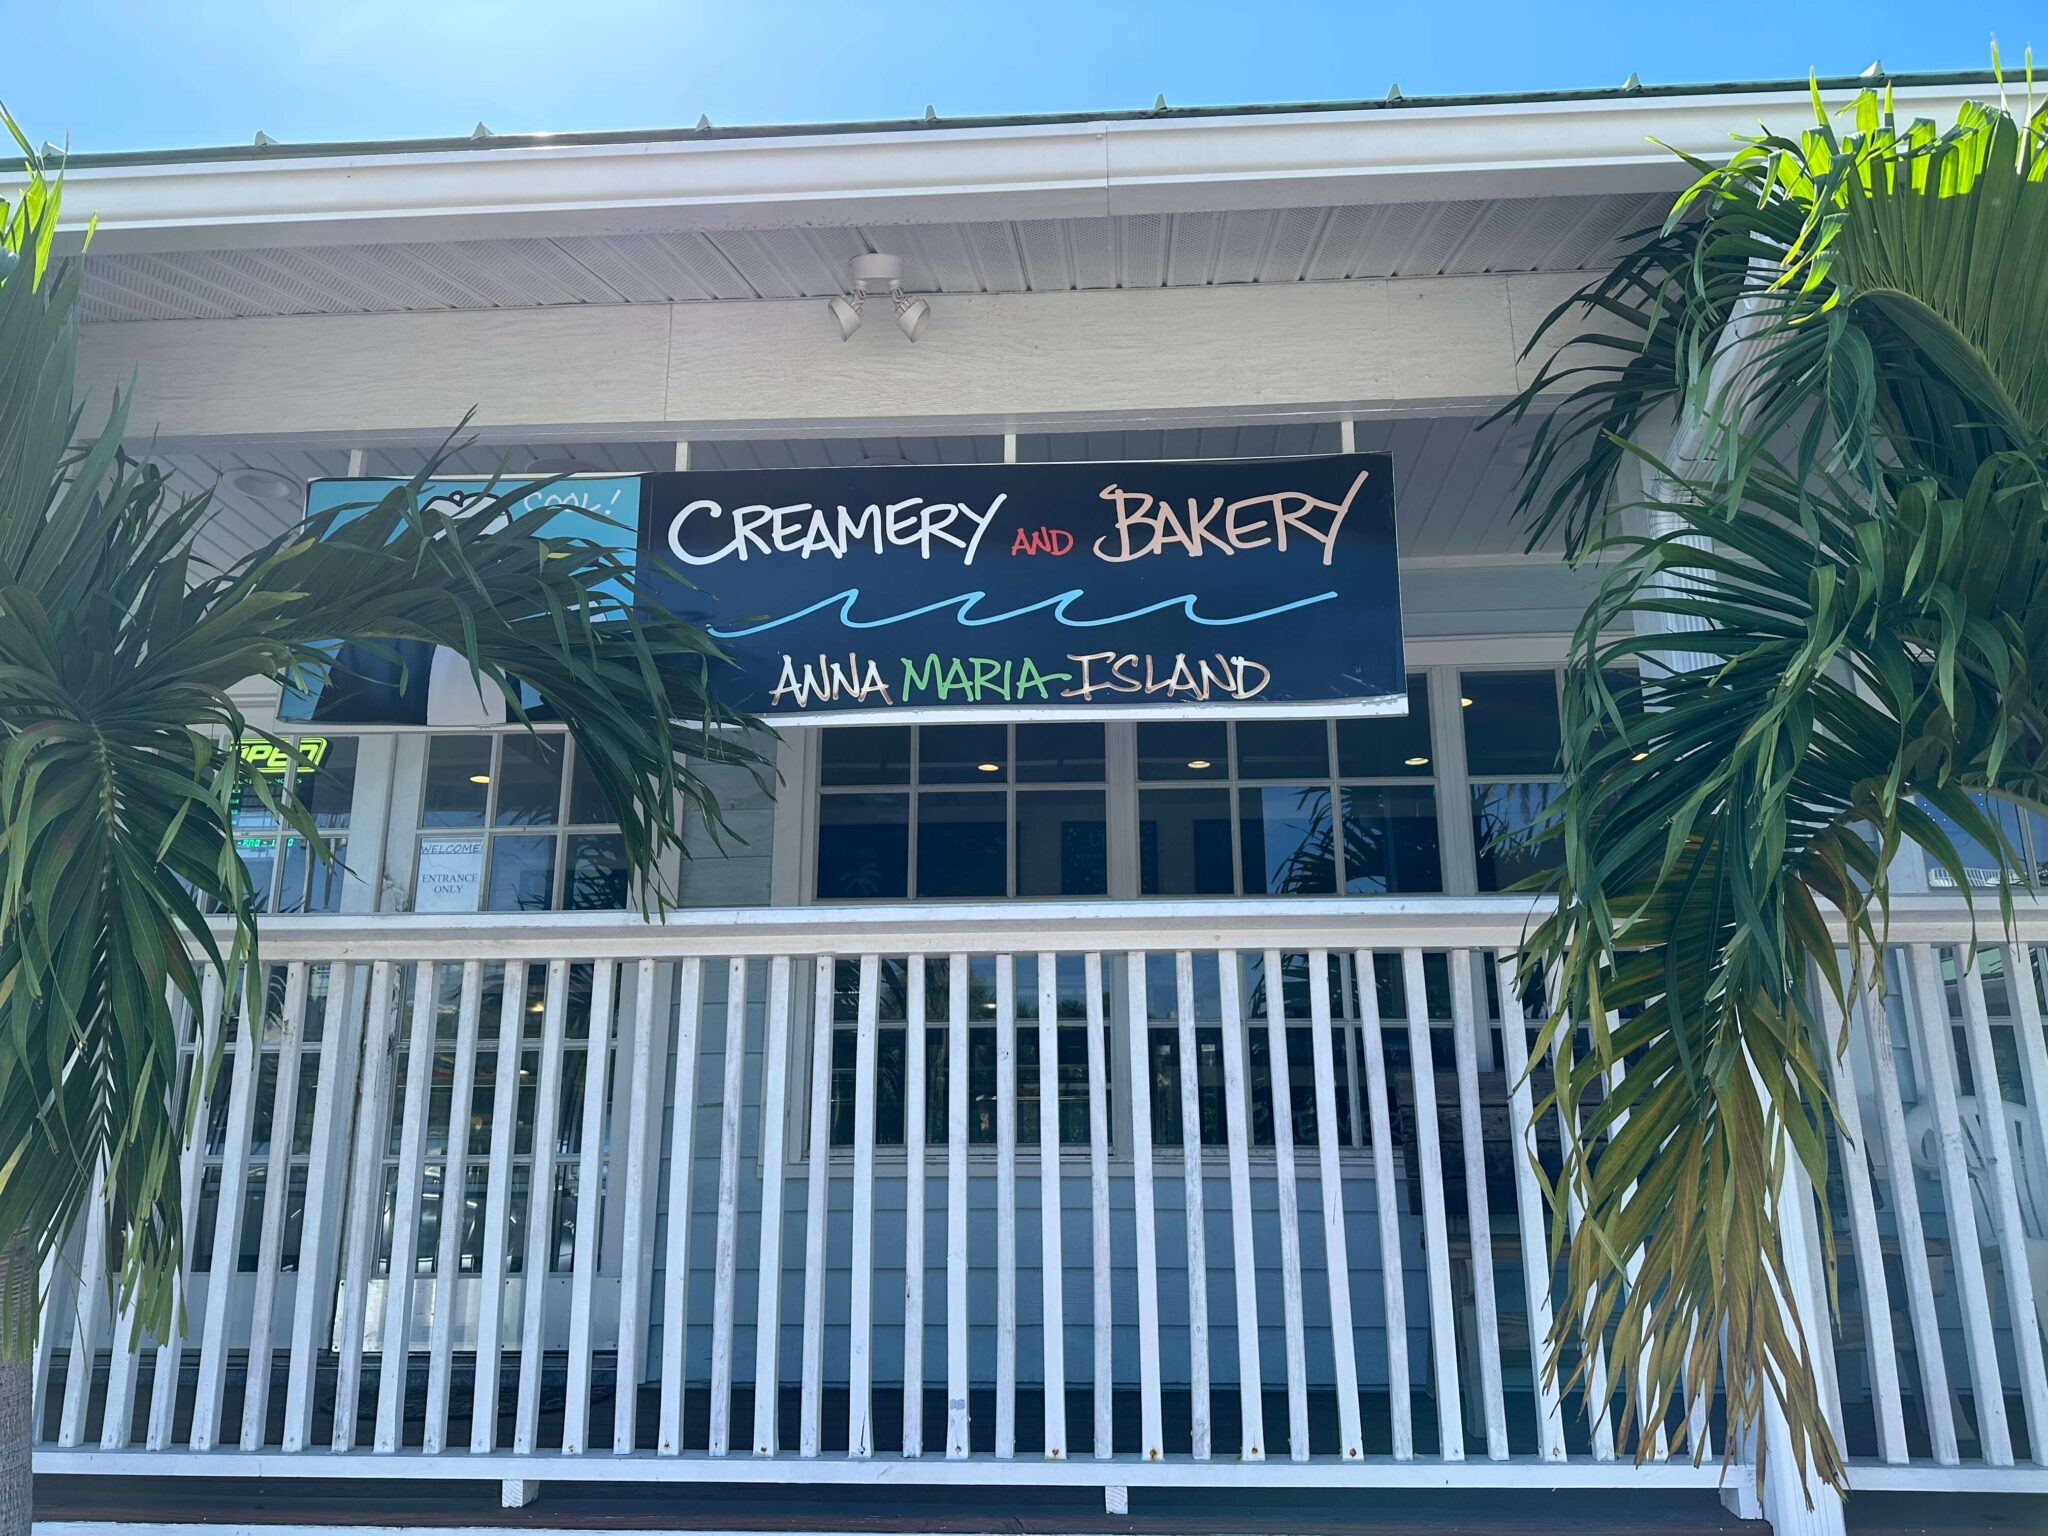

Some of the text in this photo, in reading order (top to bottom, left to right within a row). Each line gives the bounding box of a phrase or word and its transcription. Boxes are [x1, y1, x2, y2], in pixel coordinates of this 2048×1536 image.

[668, 470, 1369, 565] CREAMERY AND BAKERY
[769, 651, 1270, 708] ANNA MARIA ISLAND
[422, 873, 479, 883] ENTRANCE
[434, 885, 464, 894] ONLY
